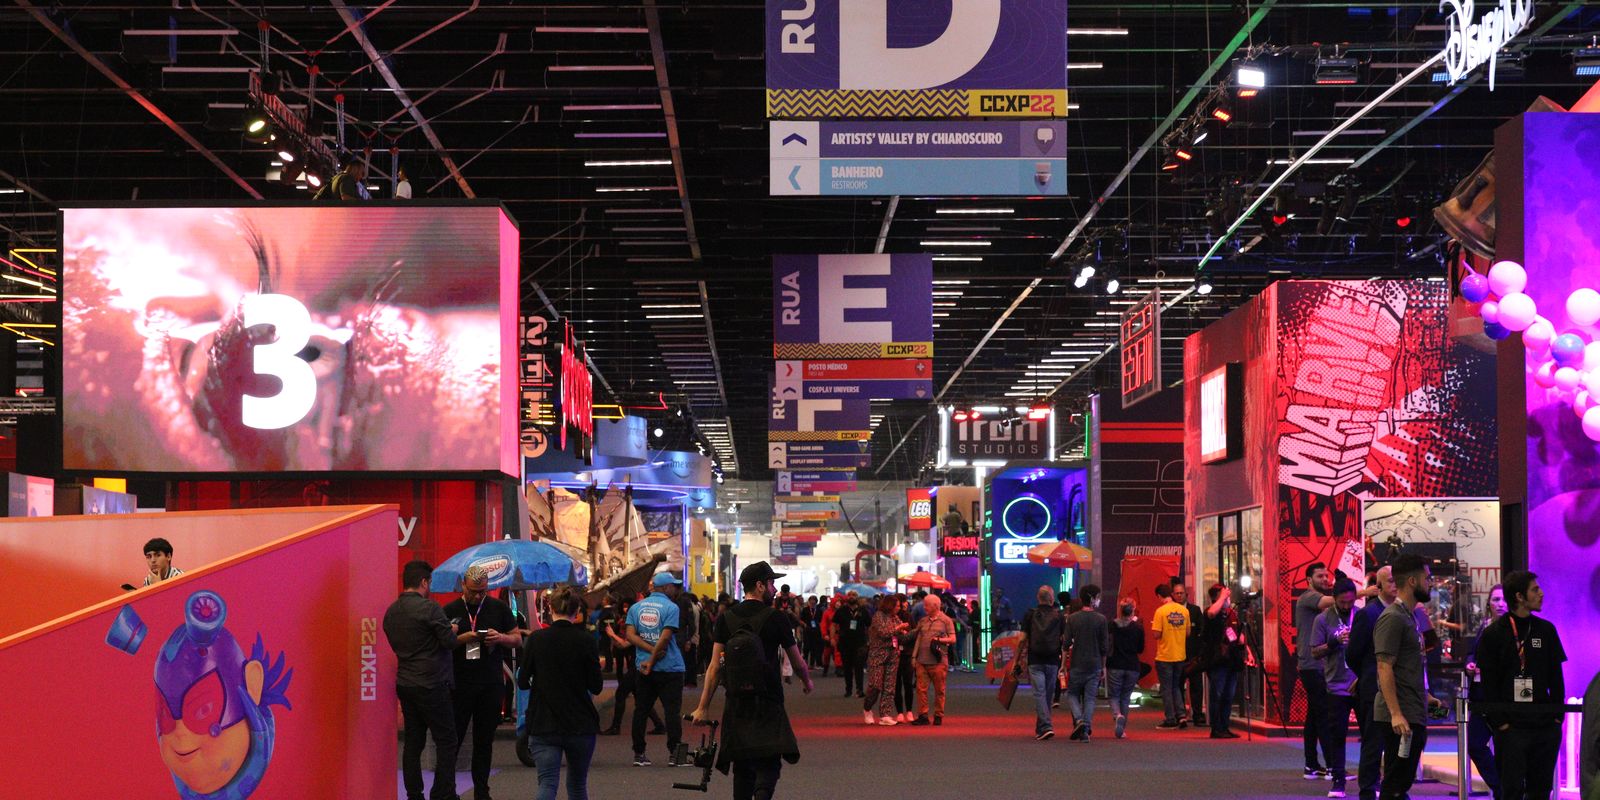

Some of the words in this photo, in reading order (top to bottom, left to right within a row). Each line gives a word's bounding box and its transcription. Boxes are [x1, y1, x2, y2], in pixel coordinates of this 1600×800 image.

[980, 95, 1055, 113] CCXP22
[878, 133, 912, 145] VALLEY
[913, 133, 929, 145] BY
[931, 133, 1003, 145] CHIAROSCURO
[831, 166, 884, 178] BANHEIRO
[831, 180, 868, 190] RESTROOMS
[782, 271, 800, 325] RUA
[818, 254, 893, 343] E
[887, 345, 927, 355] CCXP22
[242, 294, 317, 430] 3
[808, 363, 826, 371] POSTO
[808, 386, 833, 394] COSPLAY
[833, 386, 860, 394] UNIVERSE
[959, 444, 1038, 454] STUDIOS
[361, 617, 377, 701] CCXP22
